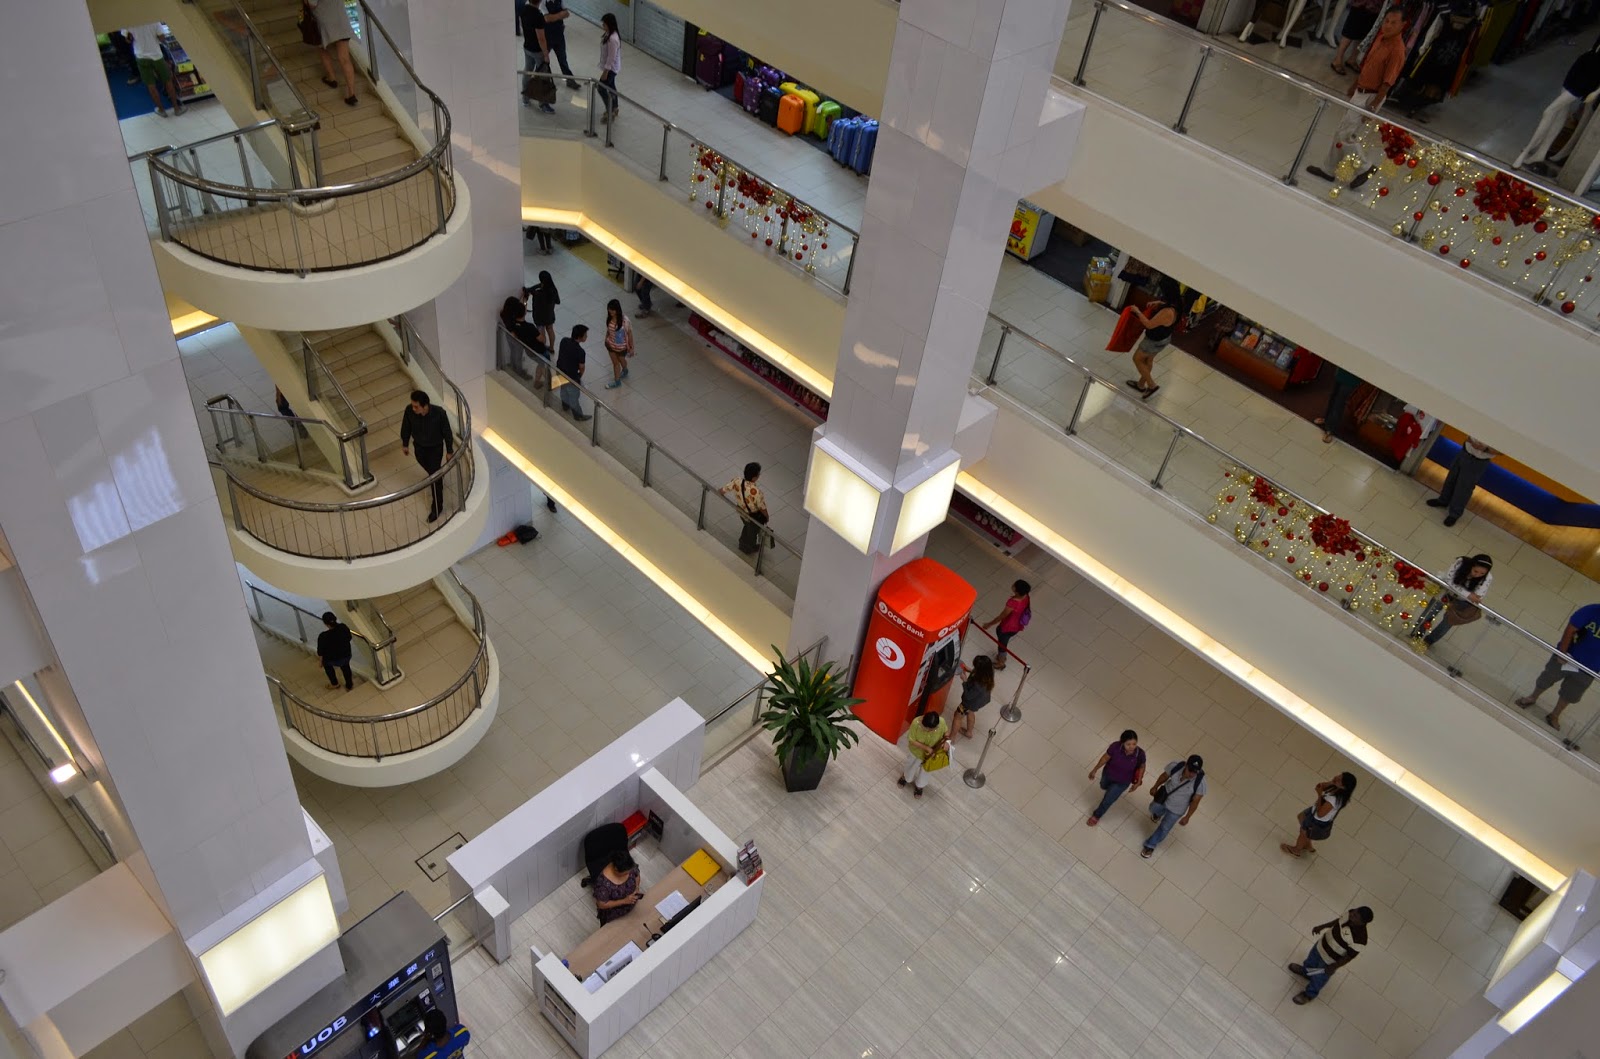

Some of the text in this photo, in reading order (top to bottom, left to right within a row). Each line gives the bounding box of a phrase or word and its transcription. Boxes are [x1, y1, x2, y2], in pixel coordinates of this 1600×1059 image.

[887, 611, 924, 638] OCBC Bank
[370, 949, 435, 1003] 大華銀行
[301, 1016, 348, 1054] UOB
